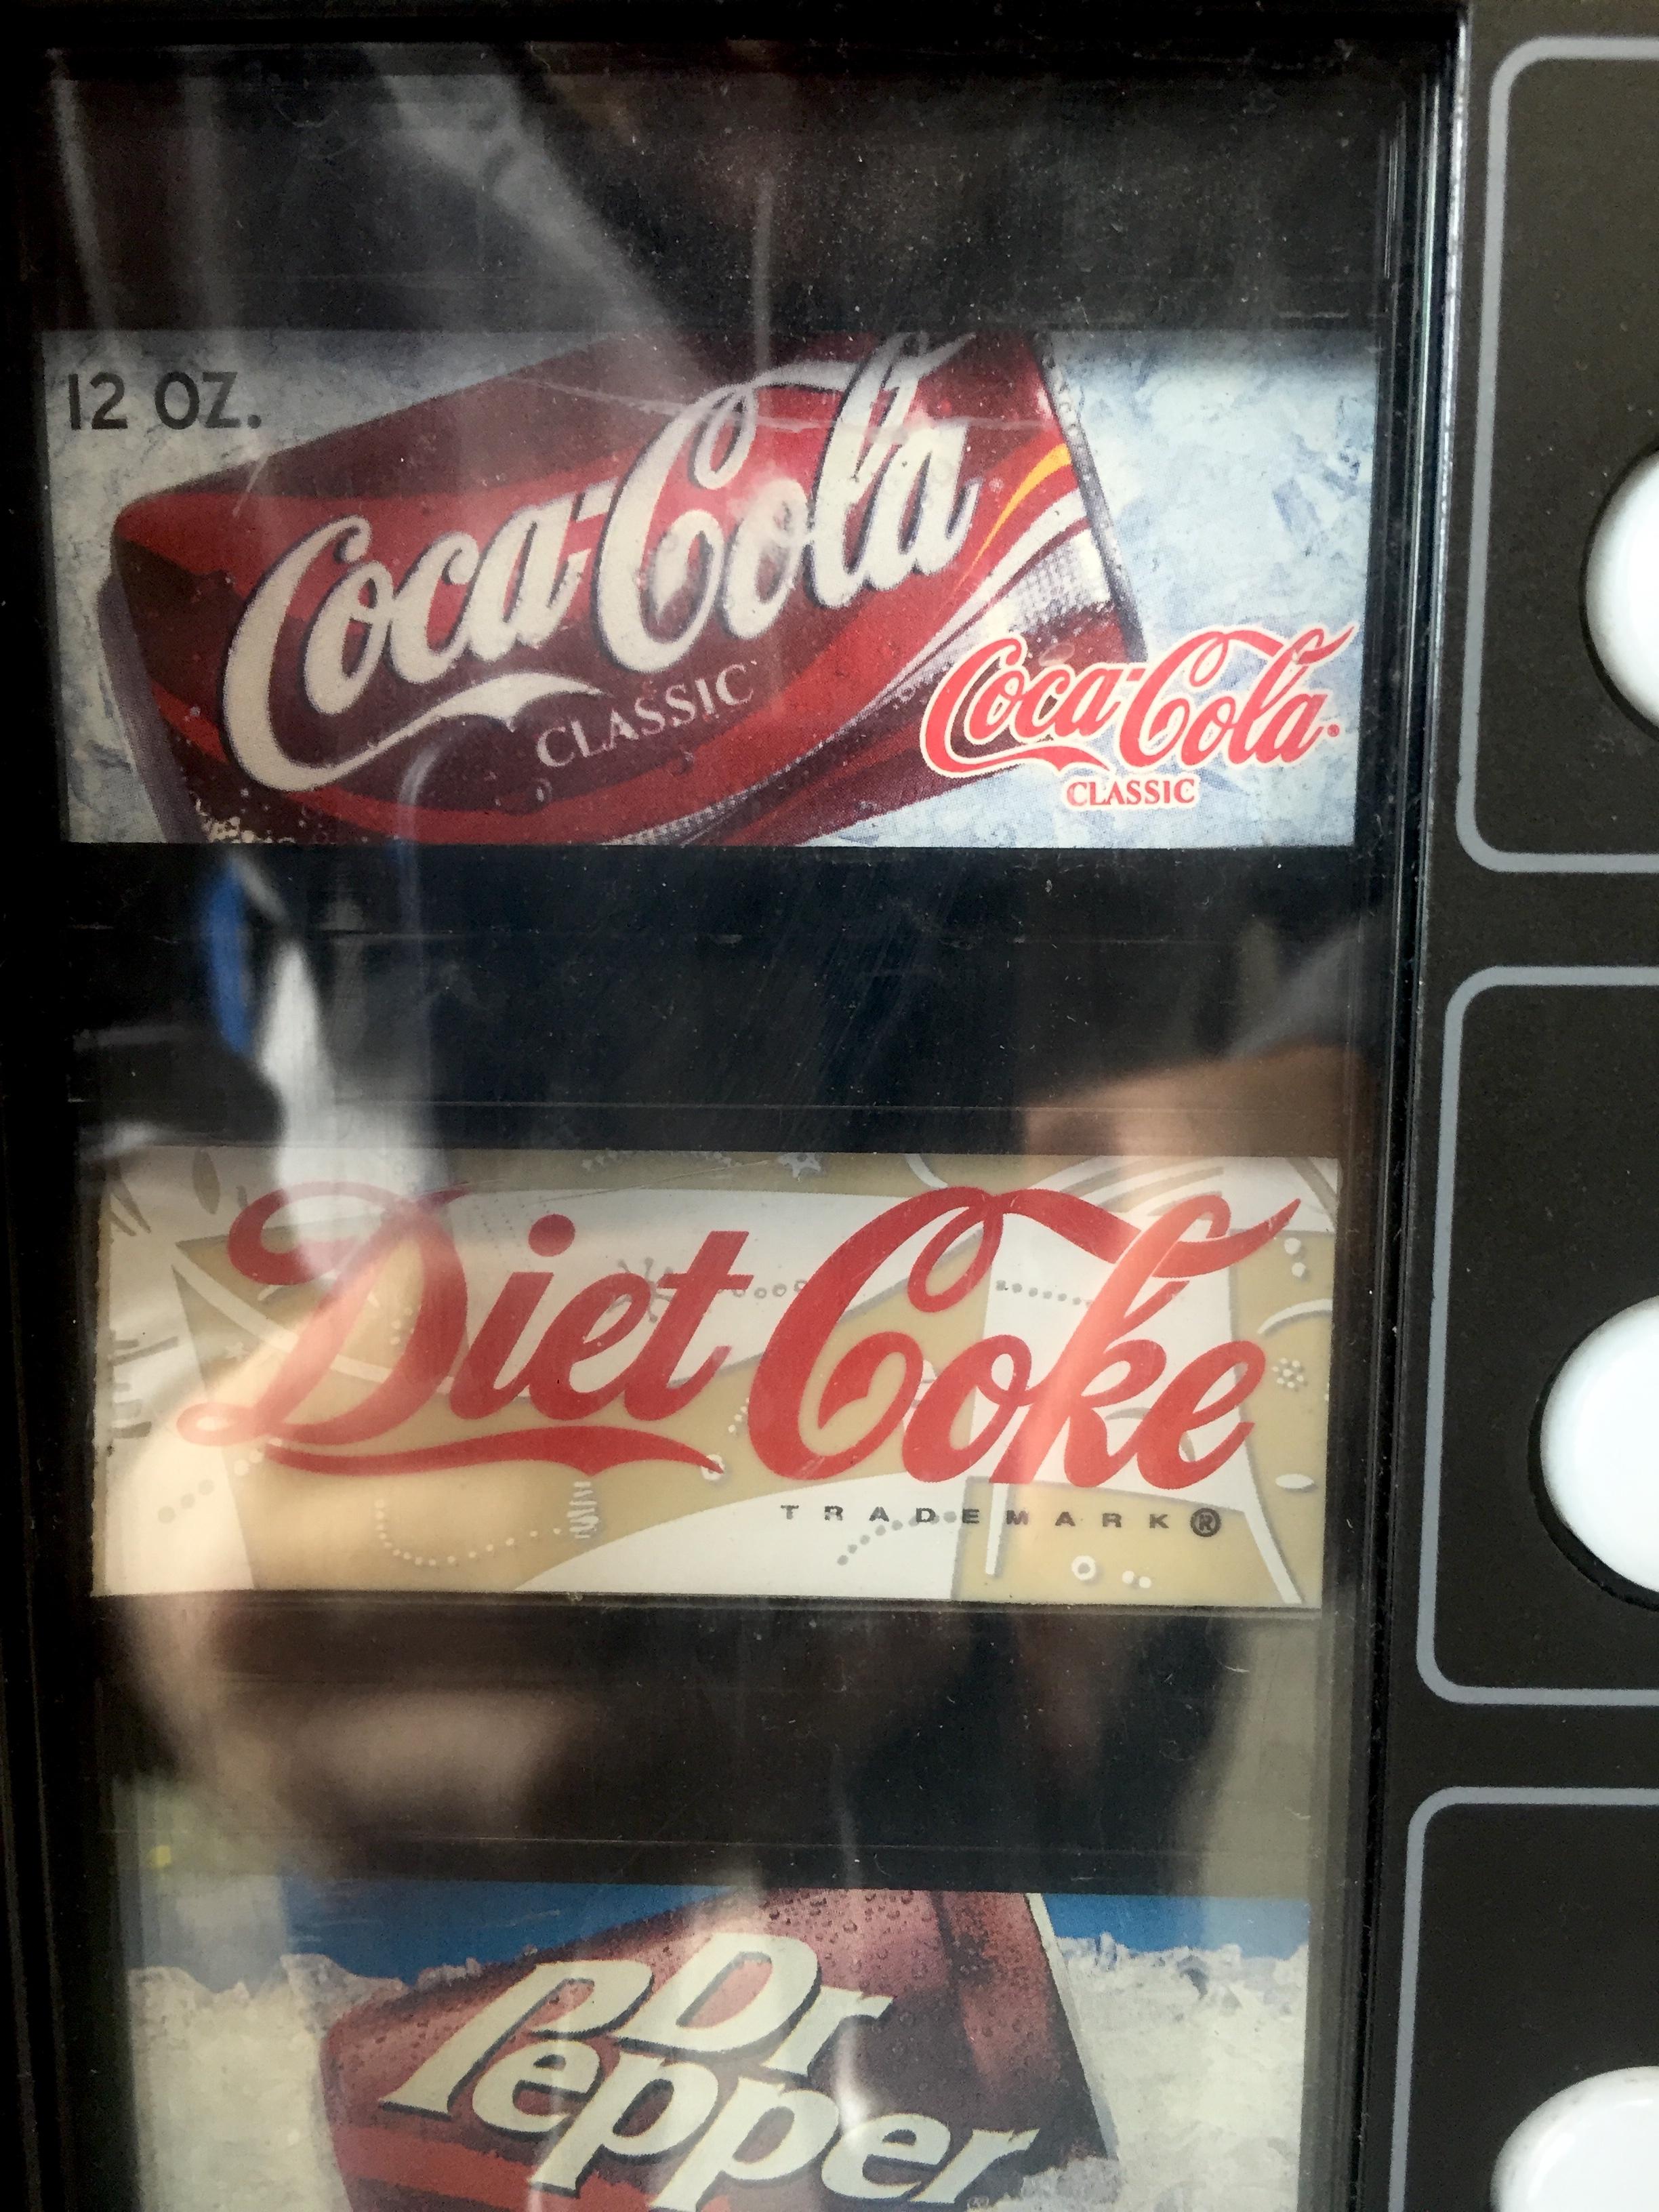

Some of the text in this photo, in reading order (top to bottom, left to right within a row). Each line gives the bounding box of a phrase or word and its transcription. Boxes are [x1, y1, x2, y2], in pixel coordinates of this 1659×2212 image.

[68, 372, 128, 430] 12
[222, 333, 983, 792] Coca-Cola
[536, 662, 755, 768] CLASSIC
[924, 624, 1355, 773] Coca-Cola
[1066, 777, 1195, 808] CLASSIC
[176, 1181, 1301, 1490] Diet Coke
[613, 1931, 894, 2078] Dr
[380, 1957, 1040, 2212] Pepper
